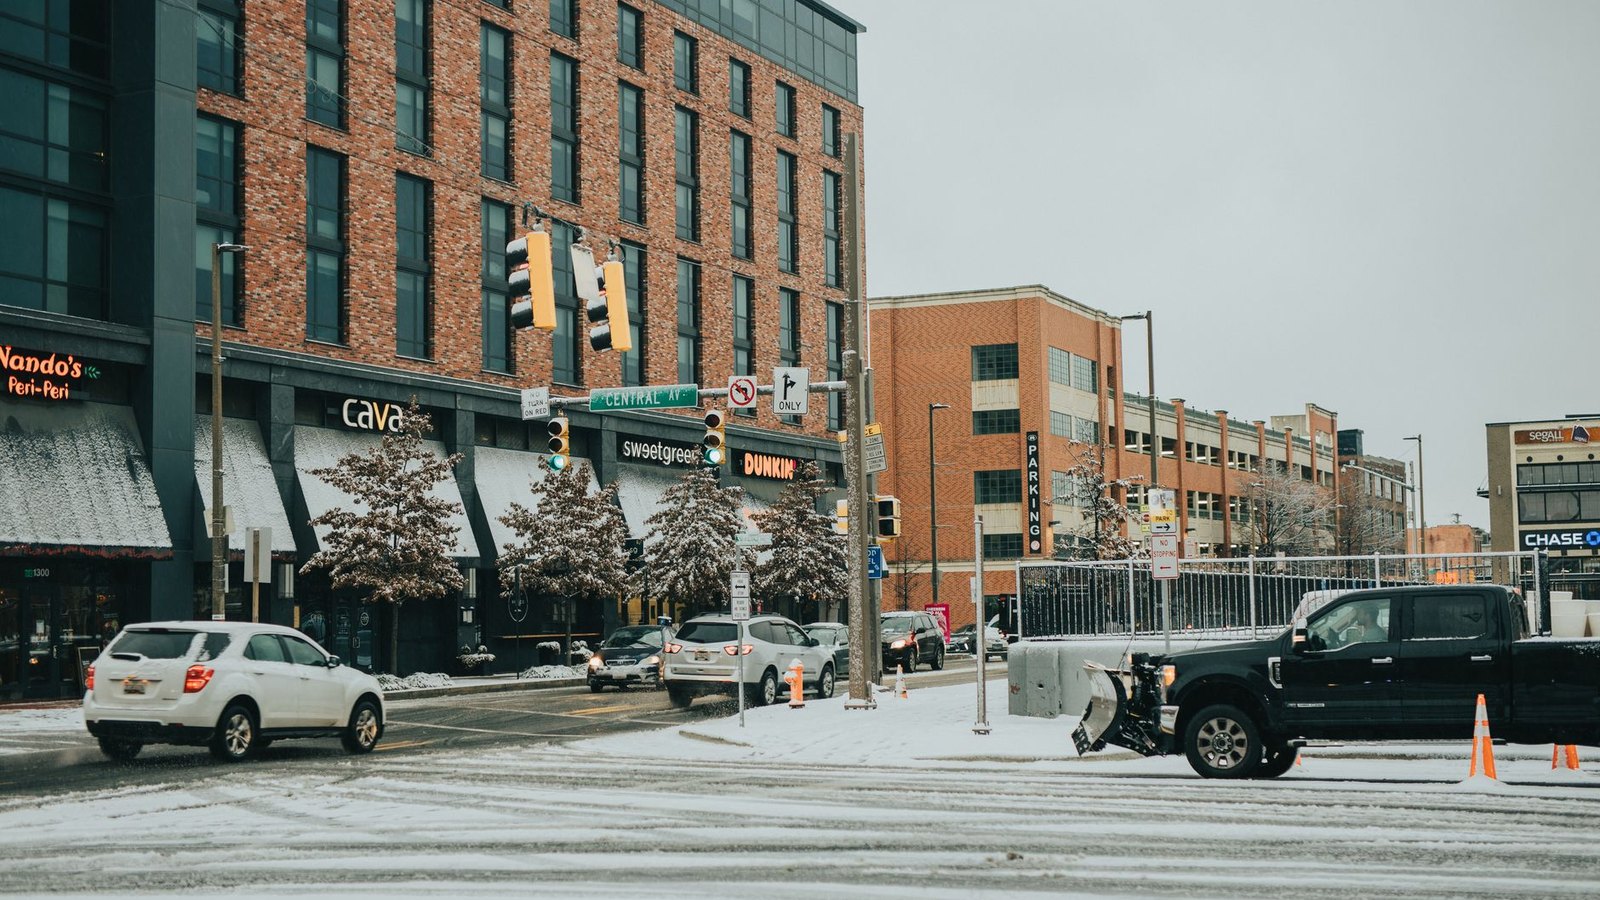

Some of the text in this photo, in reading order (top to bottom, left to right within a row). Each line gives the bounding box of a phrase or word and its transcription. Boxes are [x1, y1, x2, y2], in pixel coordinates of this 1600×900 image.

[0, 345, 82, 378] Nando's
[8, 376, 69, 400] Peri-Peri
[605, 390, 661, 407] CENTRAL
[778, 401, 802, 410] ONLY
[535, 407, 547, 415] RED
[622, 440, 695, 465] sweetgree
[744, 452, 797, 480] DUNKIN'
[1028, 445, 1040, 535] PARKING
[1524, 532, 1584, 546] CHASE
[33, 568, 50, 577] 1300
